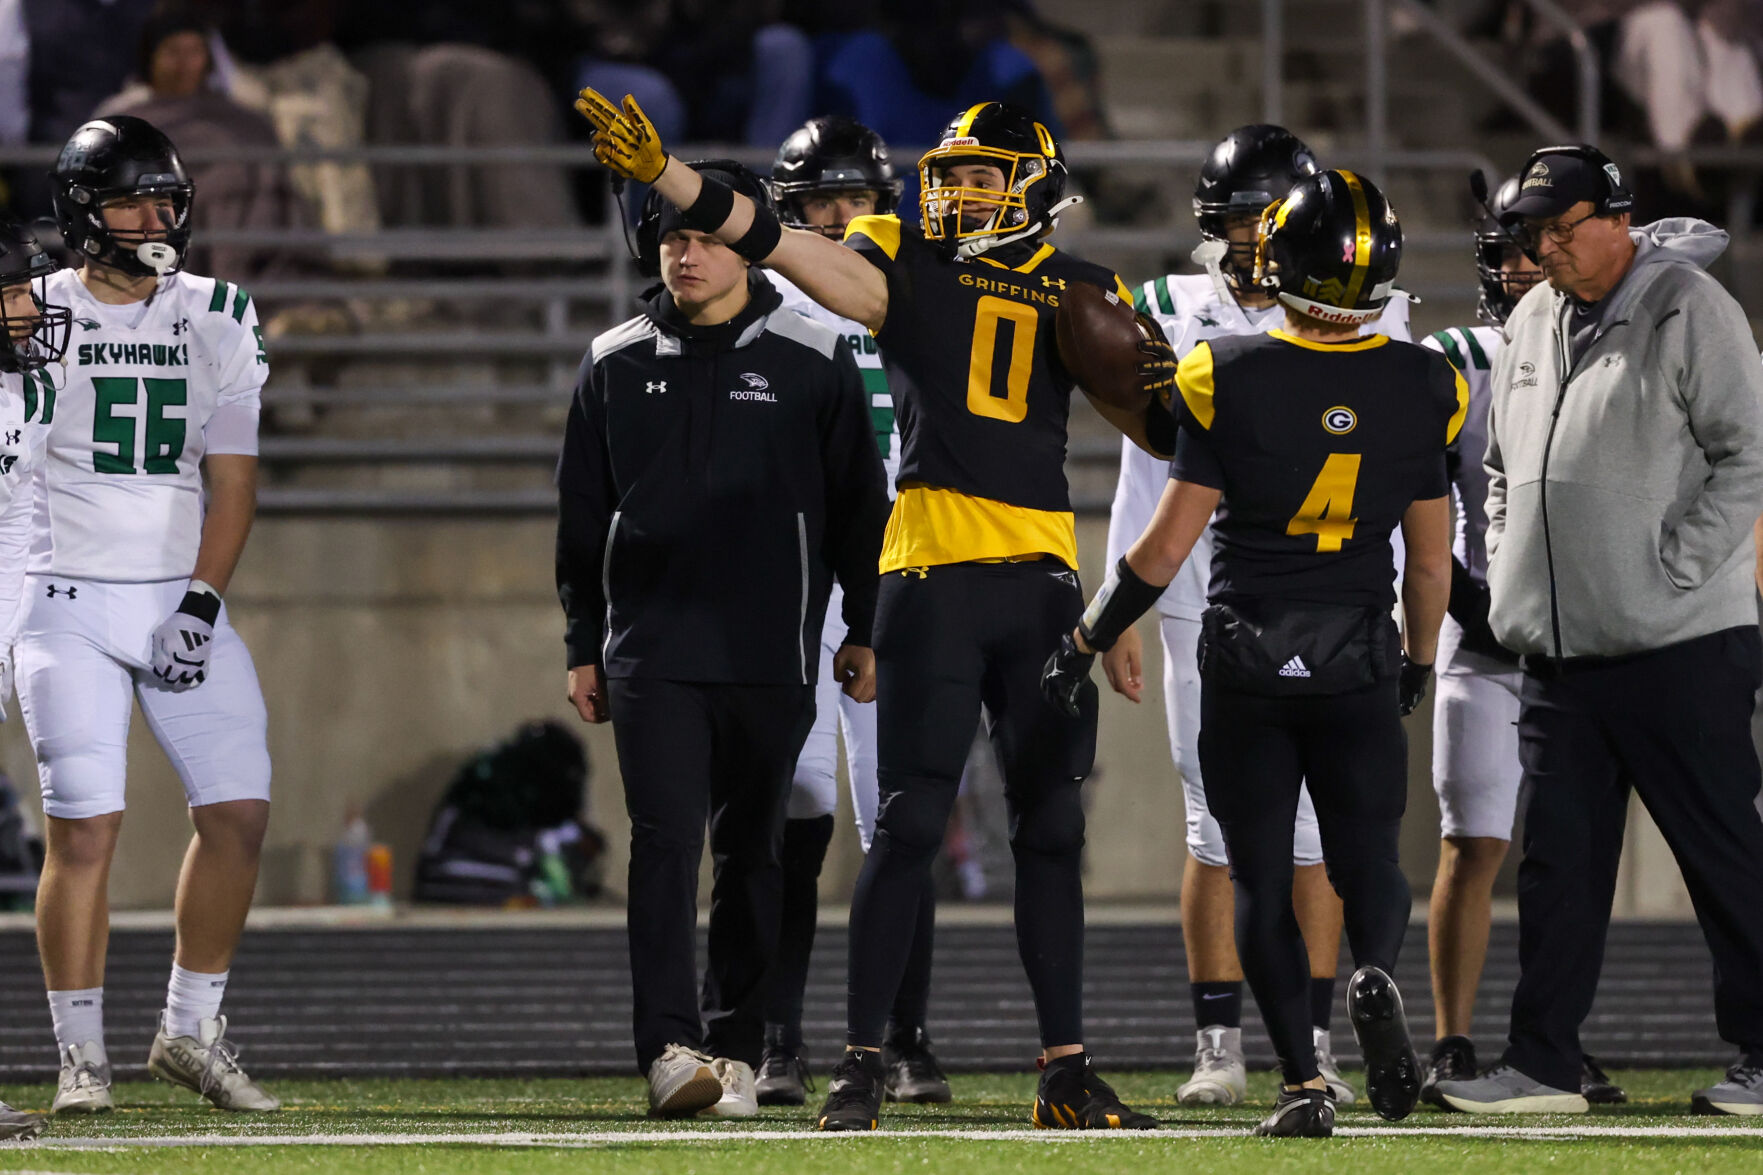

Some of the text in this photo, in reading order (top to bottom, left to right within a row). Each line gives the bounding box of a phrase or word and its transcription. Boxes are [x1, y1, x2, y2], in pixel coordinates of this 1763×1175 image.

[958, 274, 1060, 307] GRIFFINS
[967, 295, 1038, 423] 0
[730, 391, 778, 402] FOOTBALL
[90, 376, 187, 474] 56
[1327, 411, 1352, 429] G
[1286, 453, 1361, 552] 4
[1279, 668, 1311, 678] adidas
